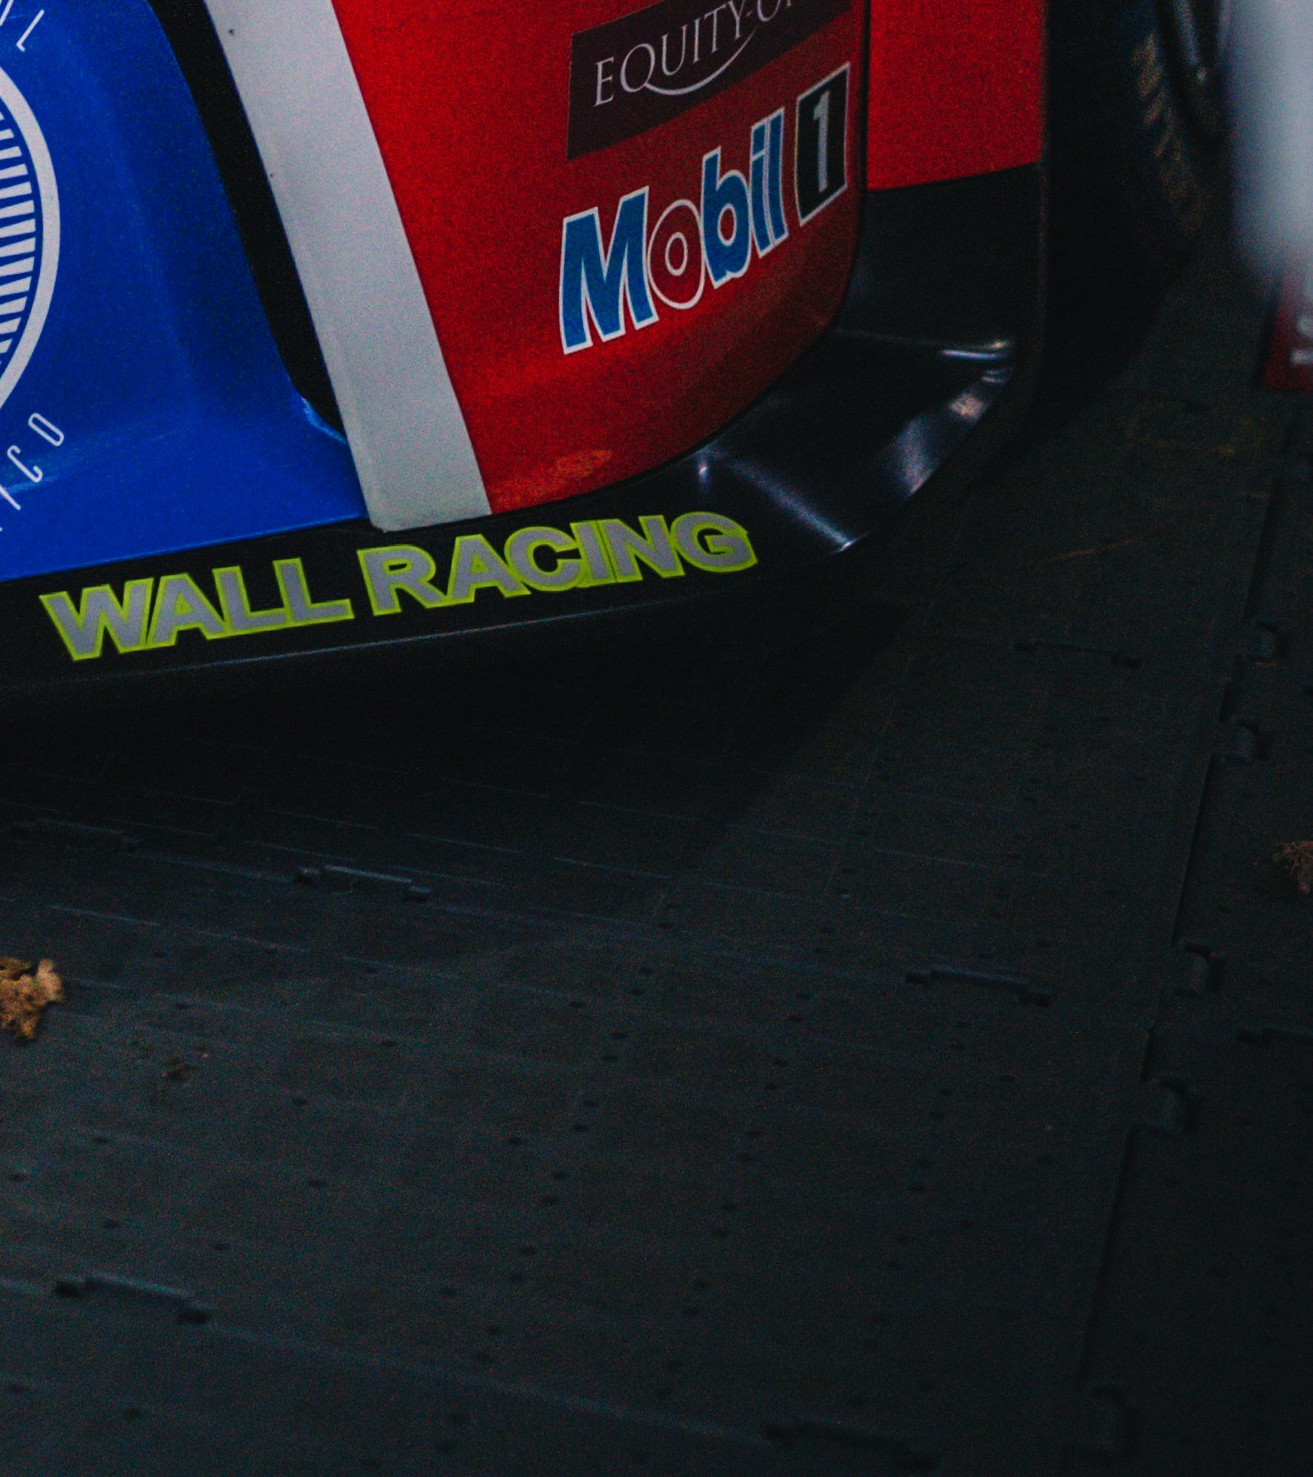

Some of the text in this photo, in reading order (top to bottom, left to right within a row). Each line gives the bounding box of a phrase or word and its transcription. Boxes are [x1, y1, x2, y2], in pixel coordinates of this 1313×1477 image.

[558, 106, 789, 356] Mobil
[39, 510, 760, 661] WALL RACING
